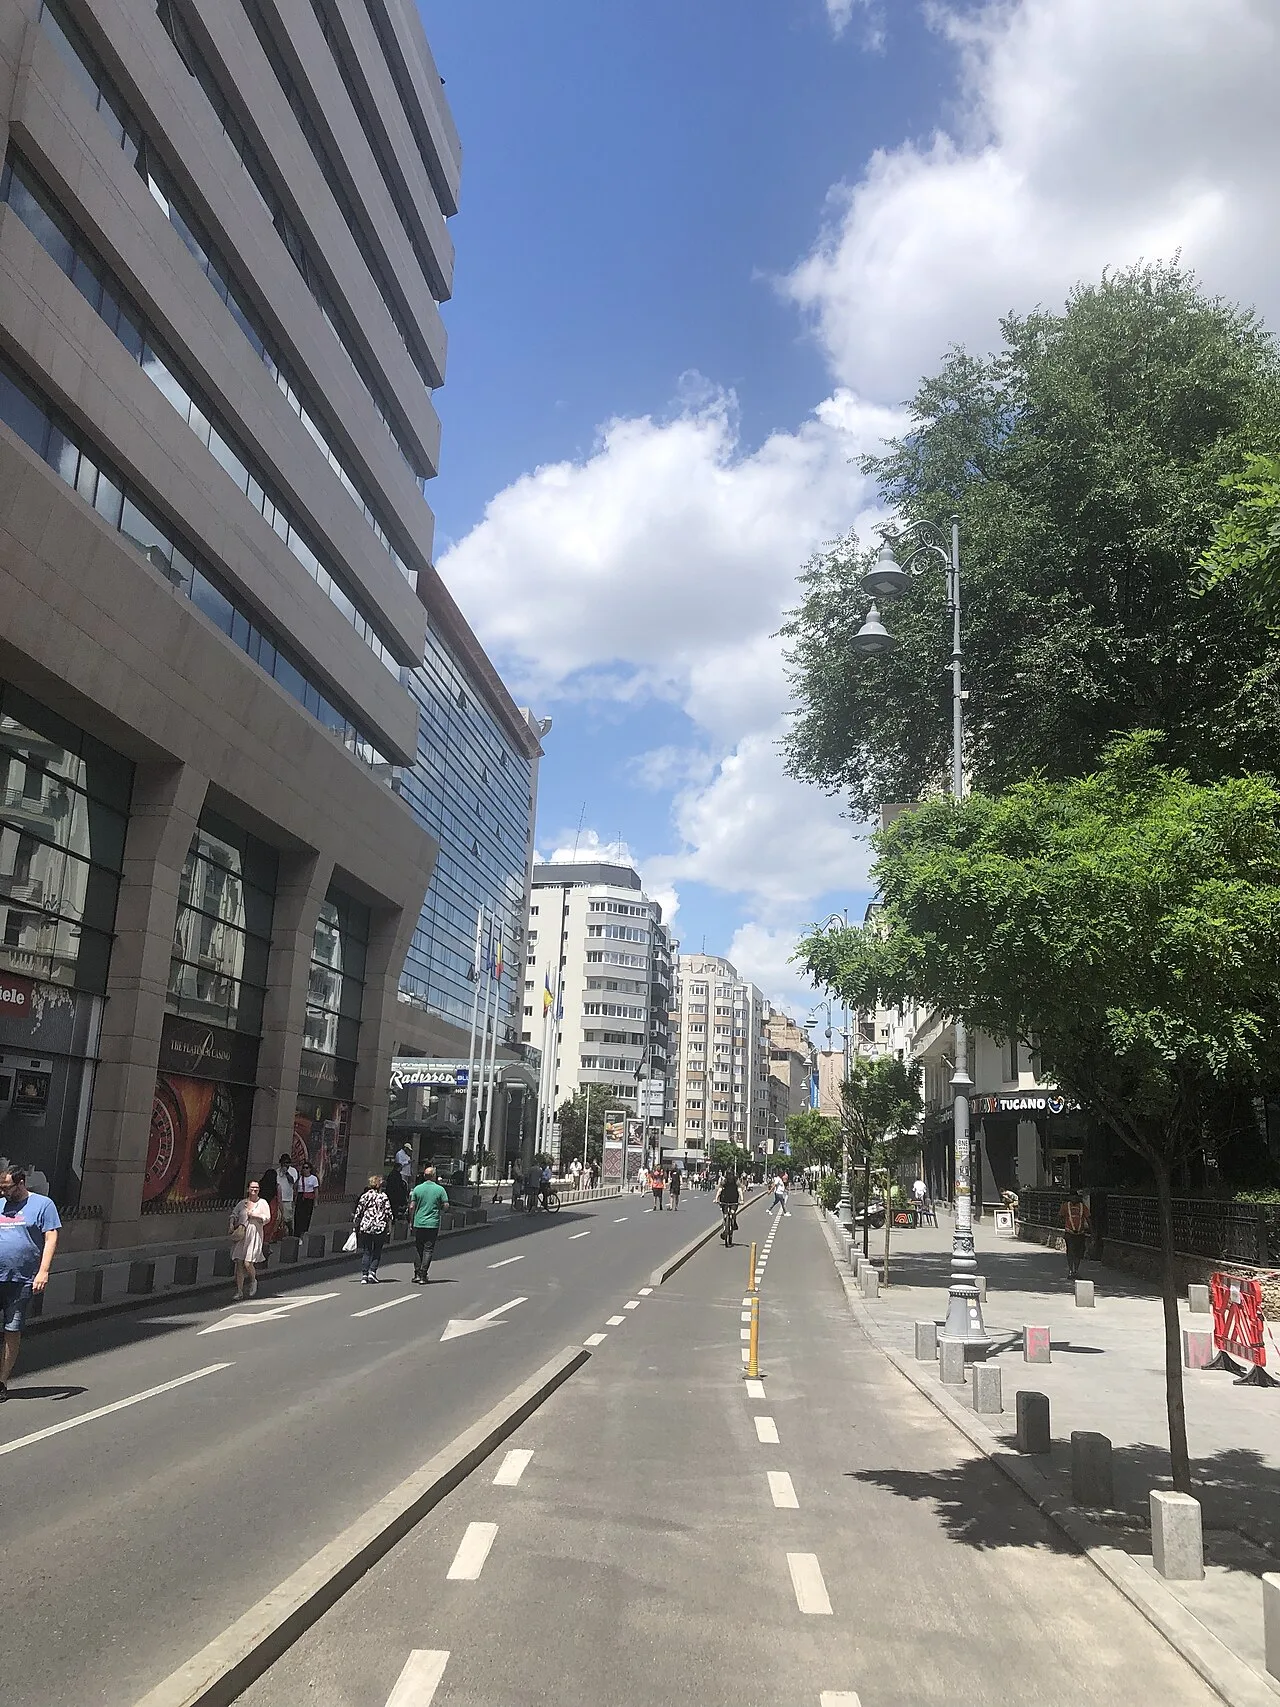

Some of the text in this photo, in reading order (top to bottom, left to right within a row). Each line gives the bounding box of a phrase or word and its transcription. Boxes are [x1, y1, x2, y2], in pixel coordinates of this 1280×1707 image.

[212, 1049, 231, 1061] CASINO
[390, 1068, 456, 1090] Radisson
[1000, 1098, 1046, 1110] TUCANO
